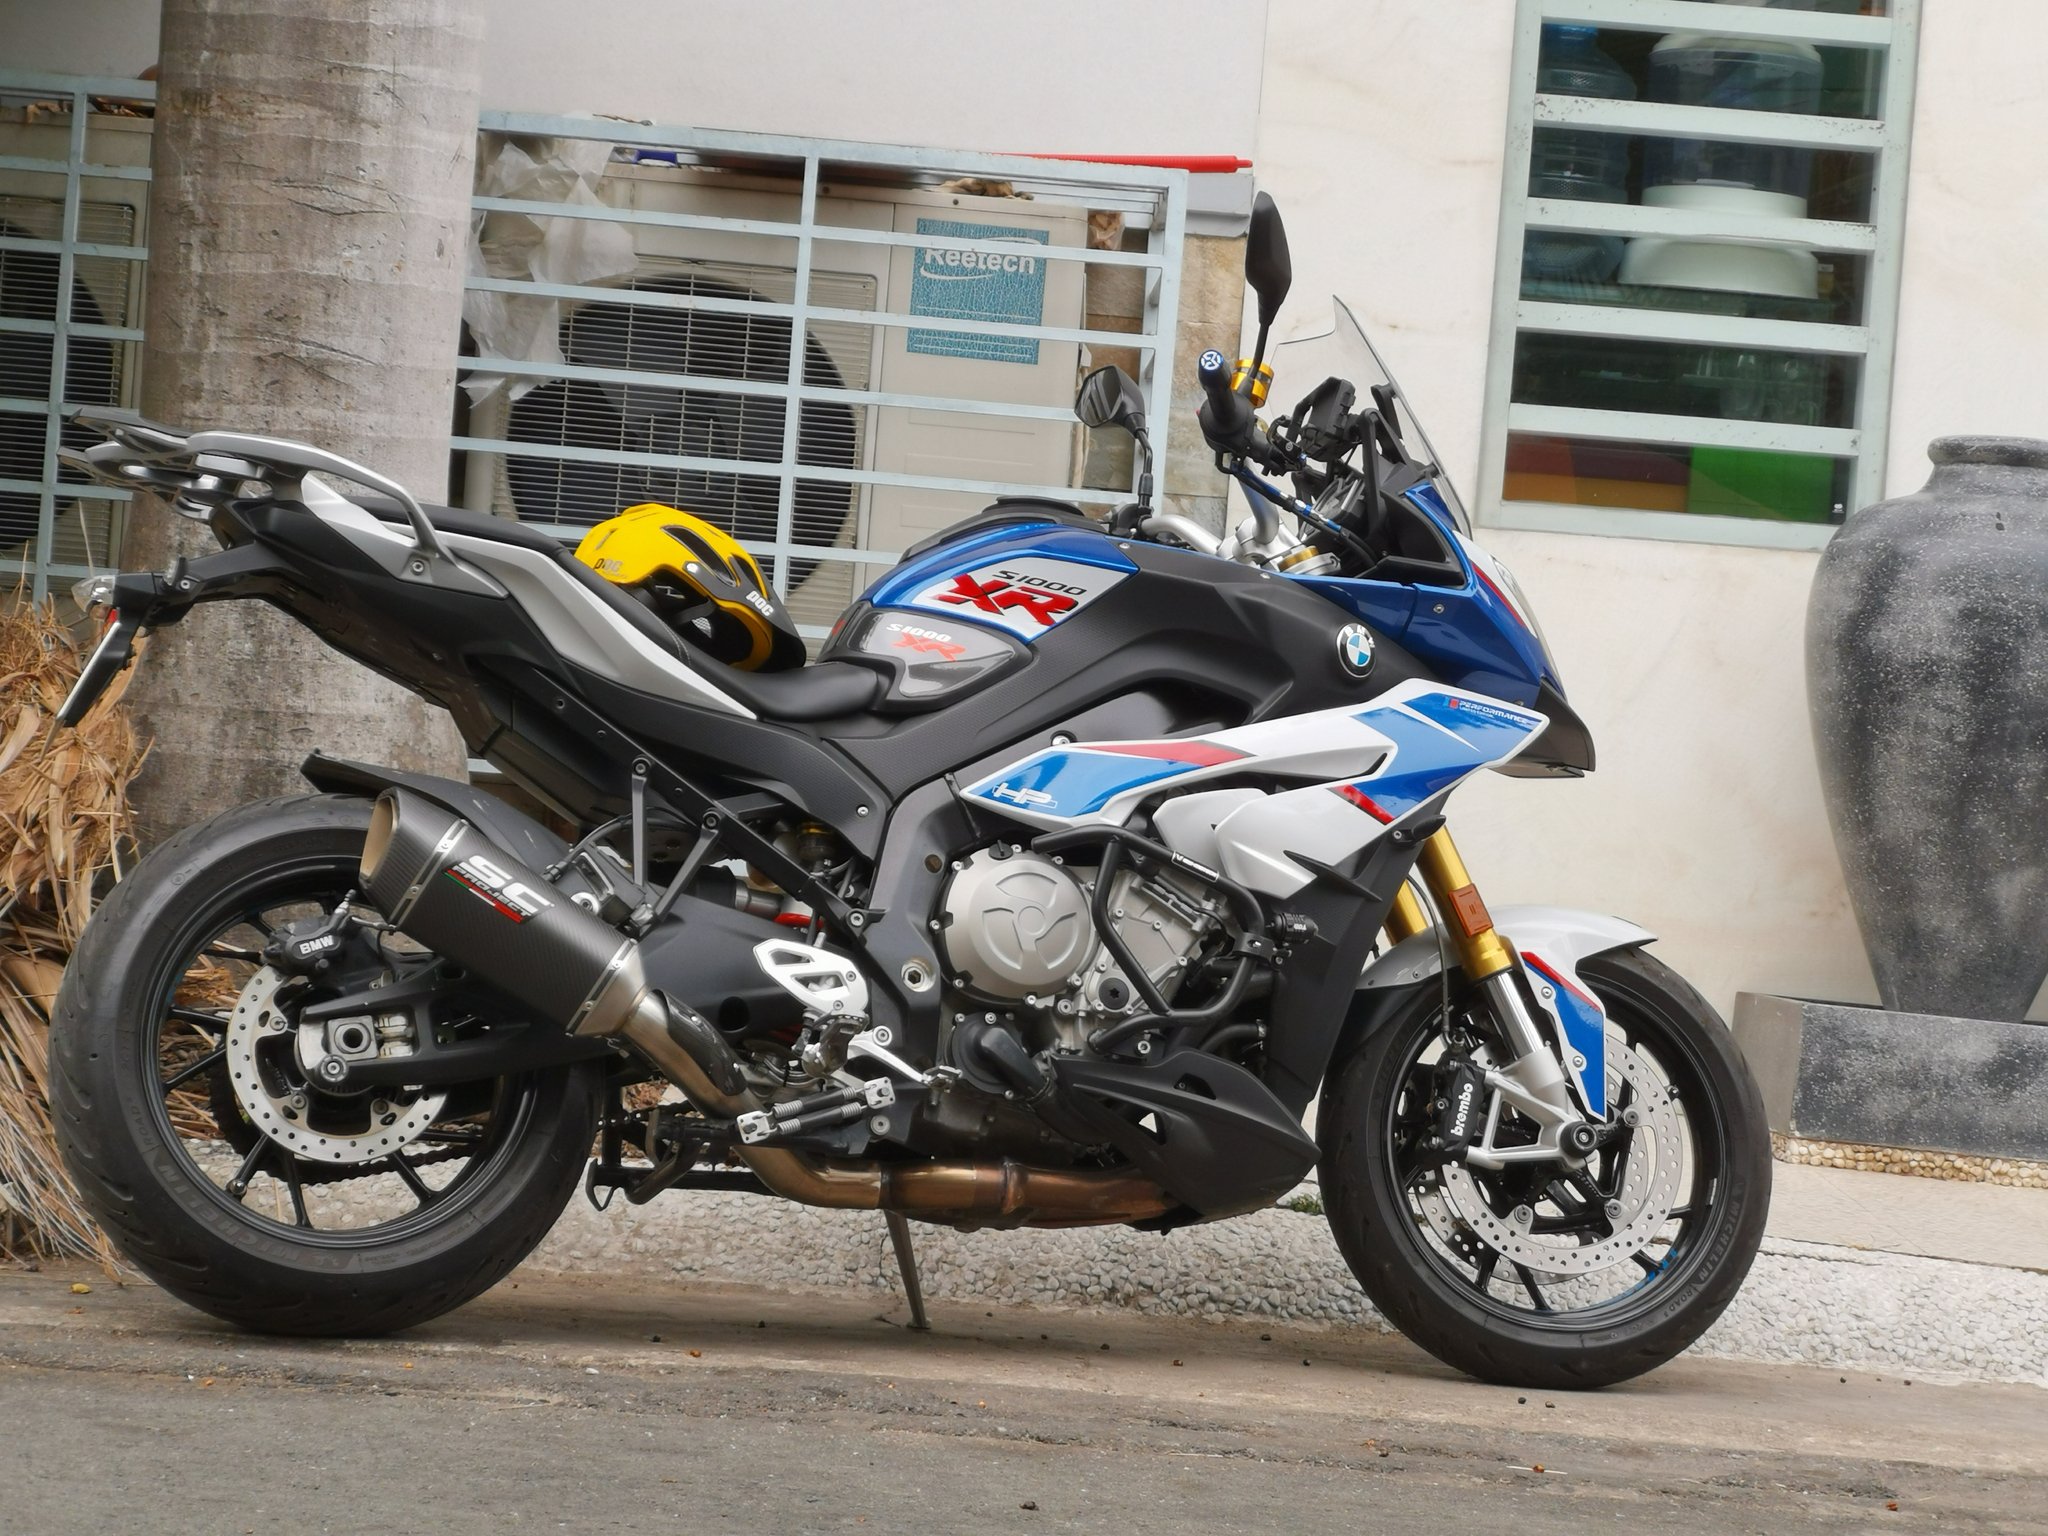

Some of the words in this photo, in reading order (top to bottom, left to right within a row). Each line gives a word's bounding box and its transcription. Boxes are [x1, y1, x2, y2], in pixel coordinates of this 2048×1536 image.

[992, 569, 1087, 597] S1000
[746, 590, 775, 617] POC
[933, 573, 1079, 626] XR
[886, 622, 952, 643] S1000
[889, 632, 967, 662] XR
[451, 865, 532, 917] PROJECT
[299, 934, 335, 955] BMW
[1450, 1083, 1473, 1136] brembo
[1700, 1202, 1740, 1283] MICHELIN
